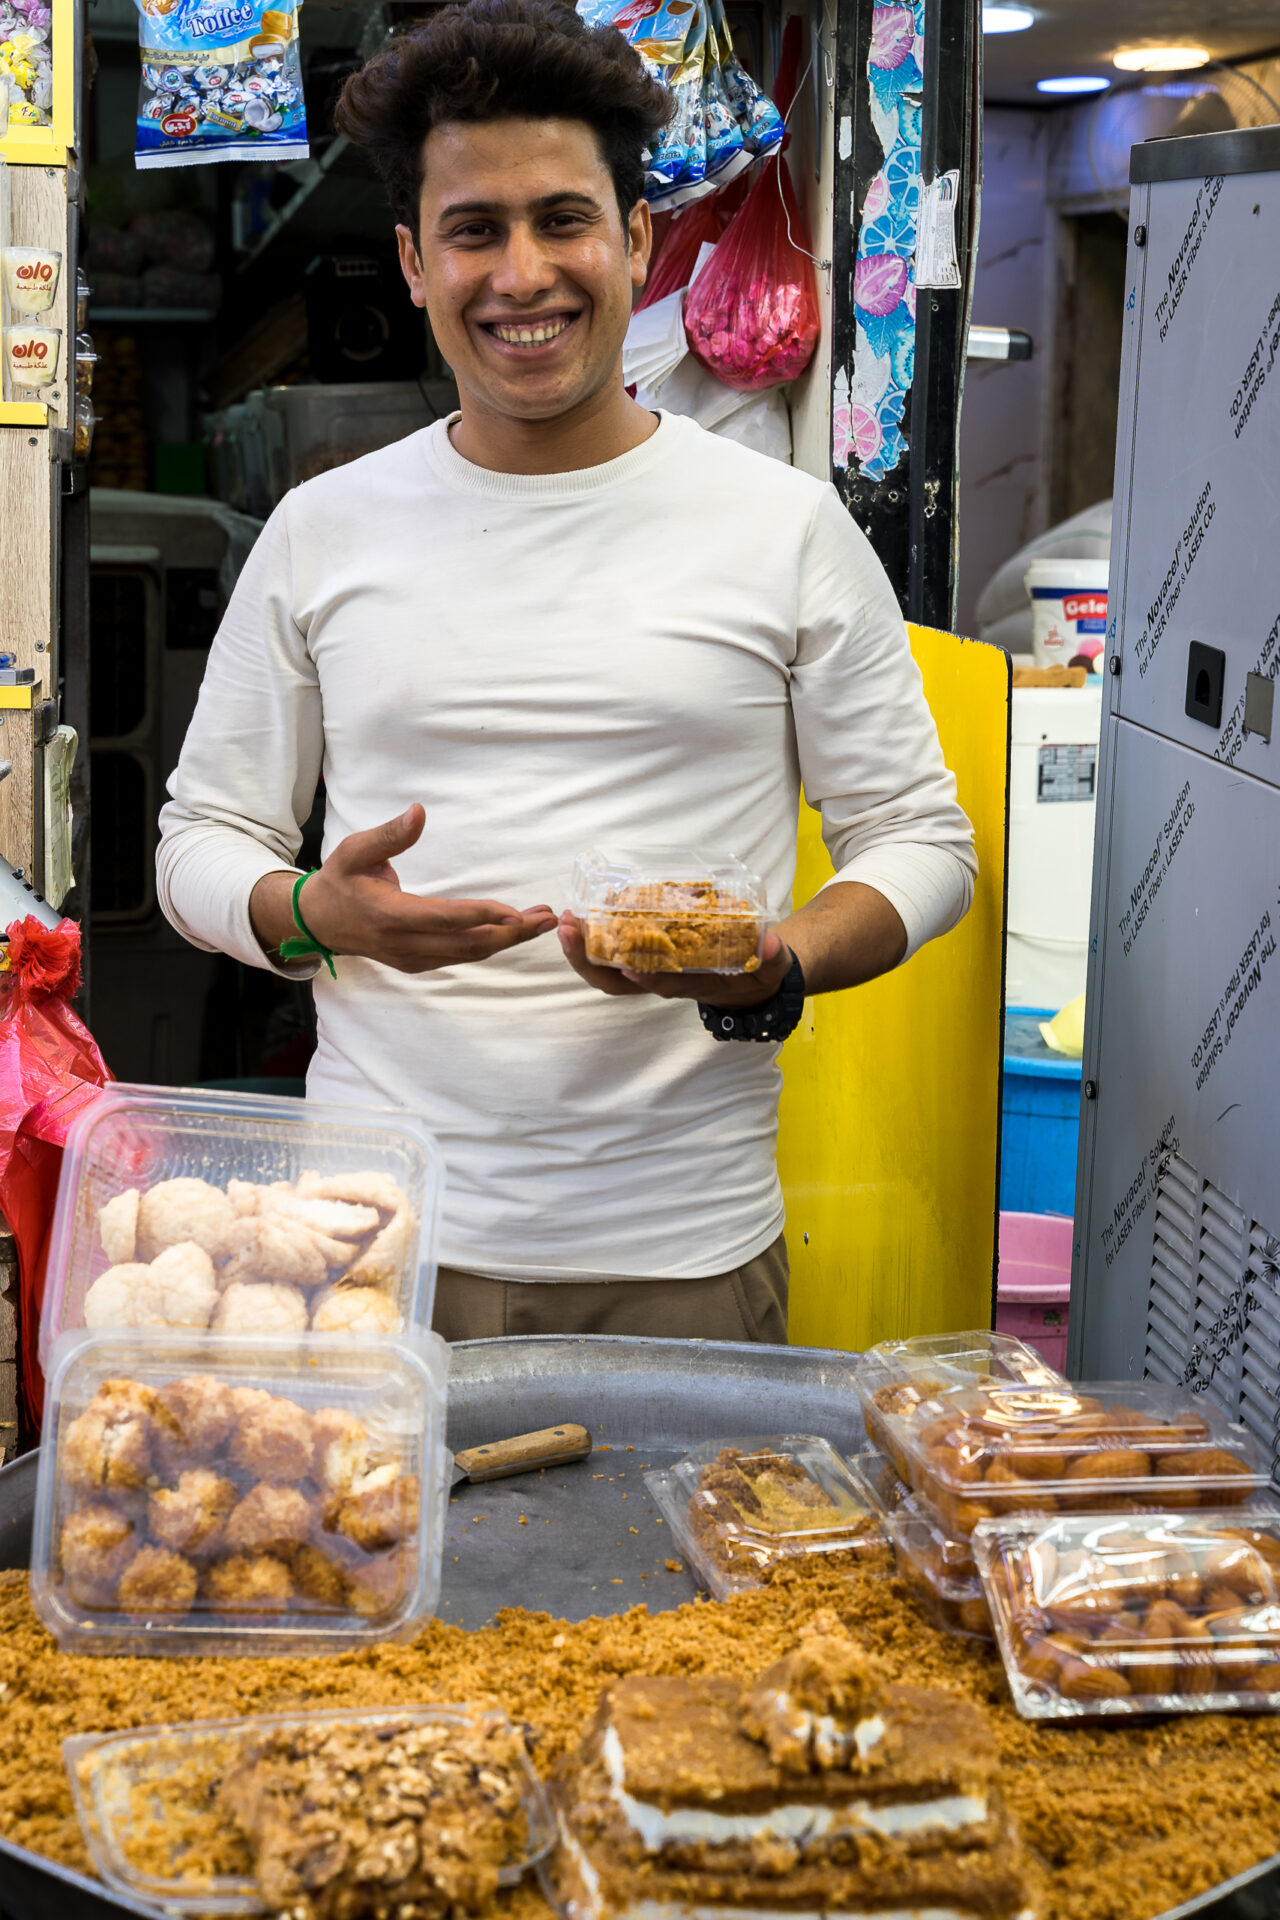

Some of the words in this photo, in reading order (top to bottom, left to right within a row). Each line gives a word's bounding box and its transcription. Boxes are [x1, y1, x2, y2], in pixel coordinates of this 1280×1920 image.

[186, 3, 254, 37] Toffee
[1155, 292, 1168, 323] The
[1159, 319, 1170, 343] for
[1168, 269, 1188, 321] LASER
[1187, 229, 1203, 272] Fiber
[1242, 337, 1264, 392] LASER
[1235, 367, 1266, 439] Solution
[1134, 630, 1148, 659] The
[1182, 481, 1212, 547] Solution
[1066, 599, 1107, 615] Gele
[1139, 652, 1149, 679] for
[1147, 618, 1167, 661] LASER
[1165, 582, 1182, 619] Fiber
[1184, 527, 1205, 575] LASER
[1219, 704, 1242, 753] LASER
[1118, 910, 1132, 936] The
[1163, 780, 1191, 839] Solution
[1123, 937, 1133, 957] for
[1131, 901, 1150, 941] LASER
[1148, 870, 1163, 904] Fiber
[1165, 823, 1185, 866] LASER
[1260, 910, 1271, 935] for
[1239, 929, 1262, 975] LASER
[1261, 934, 1277, 964] The
[1224, 968, 1241, 1005] Fiber
[1201, 1007, 1222, 1051] LASER
[1196, 1035, 1224, 1091] Solution
[1100, 1223, 1114, 1247] The
[1105, 1249, 1115, 1270] for
[1114, 1218, 1133, 1255] LASER
[1131, 1193, 1148, 1226] Fiber
